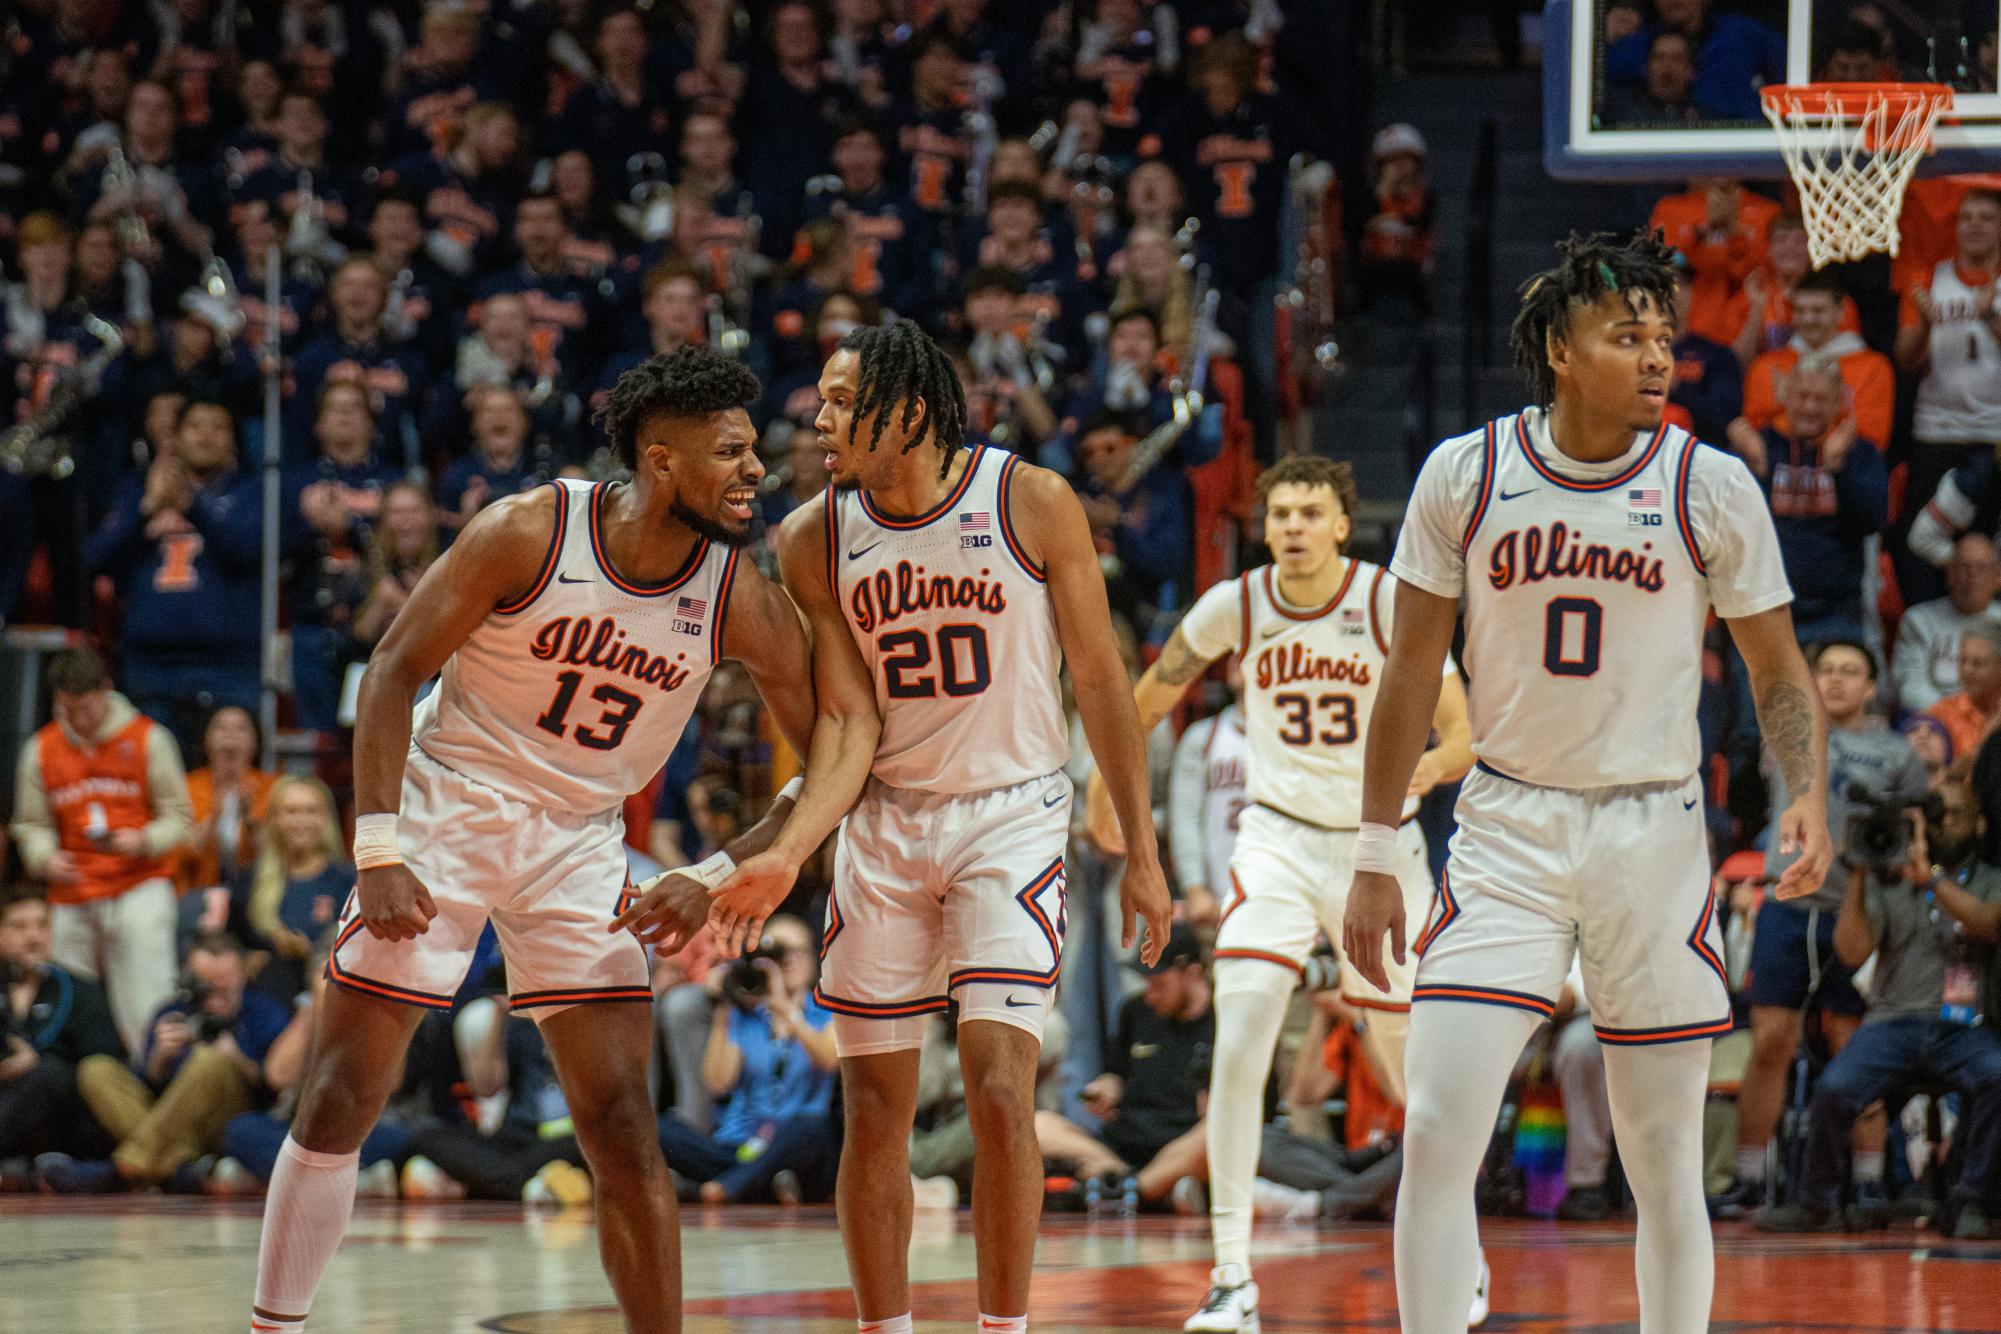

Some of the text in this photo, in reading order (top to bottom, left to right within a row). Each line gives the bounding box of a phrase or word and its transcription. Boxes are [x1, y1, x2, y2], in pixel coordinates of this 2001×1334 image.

[960, 535, 992, 549] B1G
[1628, 512, 1662, 526] B1G
[1488, 520, 1665, 594] Illinois
[672, 618, 702, 637] B1G
[852, 559, 1007, 634] Illinois
[529, 615, 690, 692] Illinois
[877, 622, 993, 700] 20
[1256, 641, 1371, 690] Illinois
[1542, 595, 1603, 679] 0
[535, 668, 645, 751] 13
[1273, 691, 1359, 745] 33
